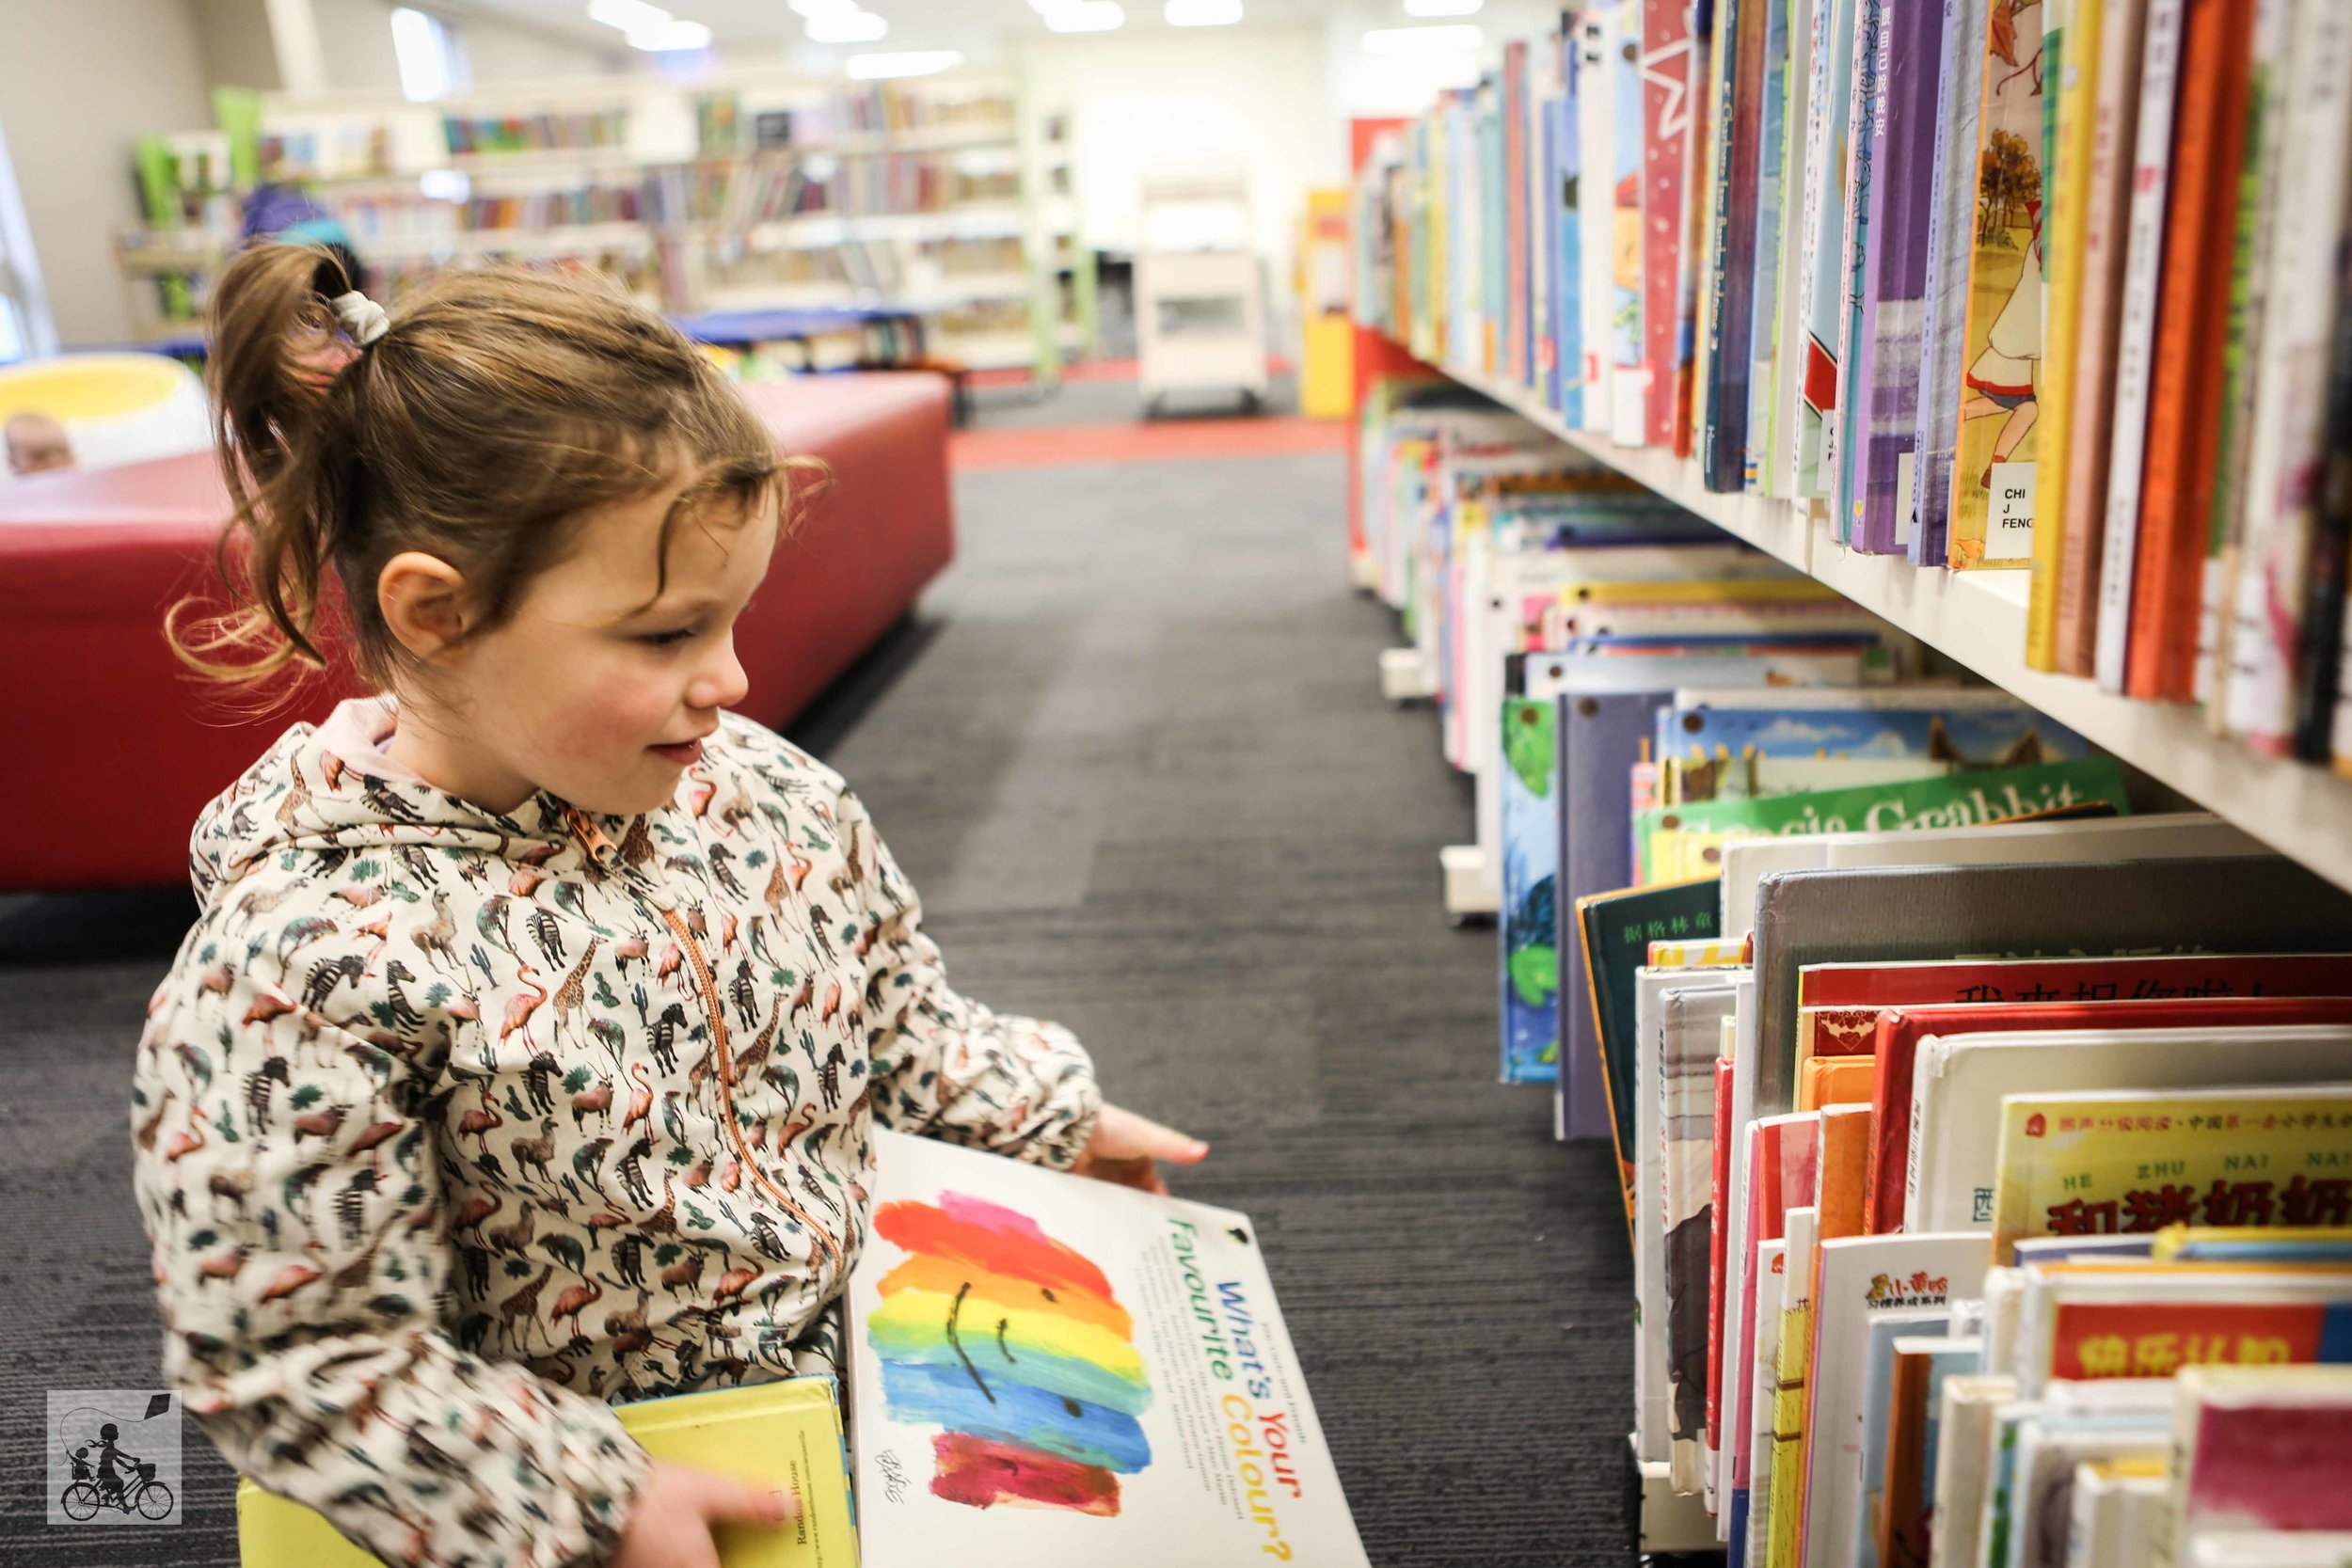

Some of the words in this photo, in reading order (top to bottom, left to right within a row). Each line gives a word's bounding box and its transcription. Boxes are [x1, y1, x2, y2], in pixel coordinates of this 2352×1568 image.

[1875, 8, 1891, 136] 跟自己說晚安
[2003, 504, 2010, 514] J
[2004, 488, 2026, 499] CHI
[2002, 518, 2034, 529] FENG
[2063, 1175, 2093, 1191] HE
[2137, 1161, 2185, 1180] ZHU
[2224, 1153, 2269, 1171] NAI
[1167, 1217, 1233, 1381] Favourite
[1221, 1393, 1293, 1562] Colour?
[1216, 1281, 1272, 1400] What's
[1258, 1413, 1303, 1498] Your
[789, 1460, 800, 1496] House
